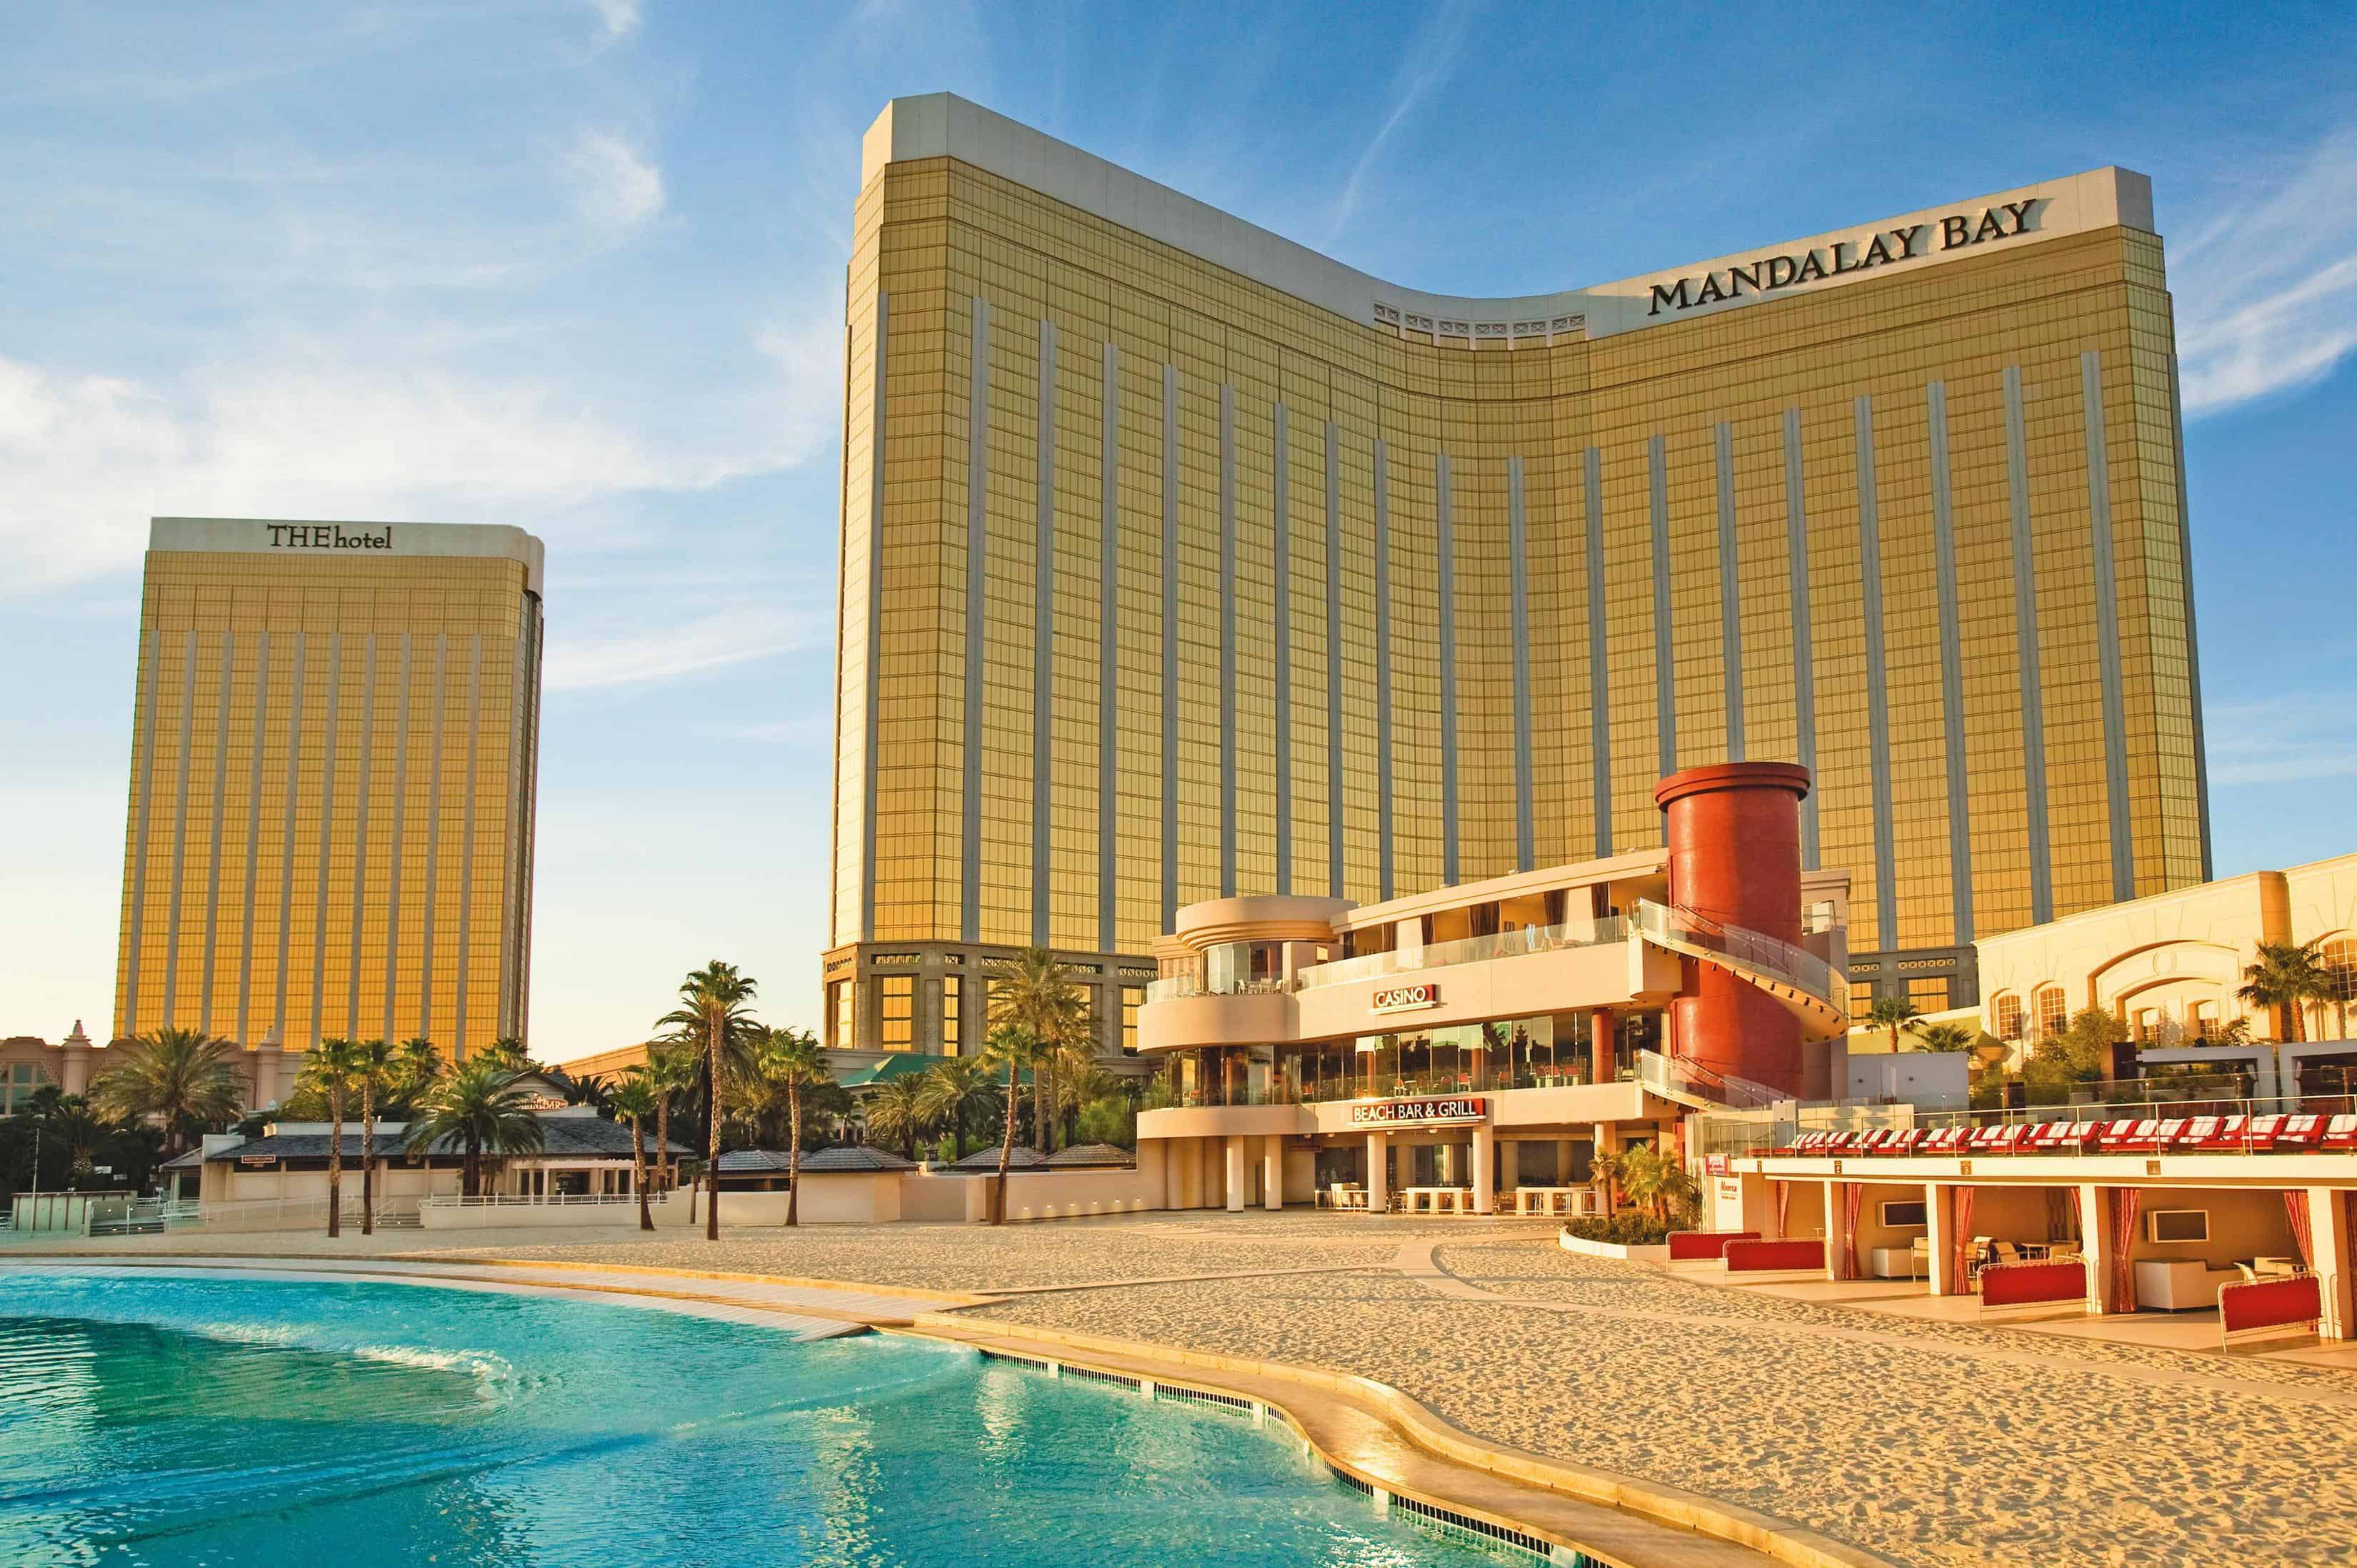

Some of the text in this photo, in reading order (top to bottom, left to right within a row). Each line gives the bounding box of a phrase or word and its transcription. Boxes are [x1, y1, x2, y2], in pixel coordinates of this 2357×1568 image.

[1648, 198, 2037, 316] MANDALAY BAY
[267, 523, 393, 549] THEhotel
[1376, 987, 1426, 1007] CASINO
[1353, 1099, 1476, 1122] BEACH BAR & GRILL
